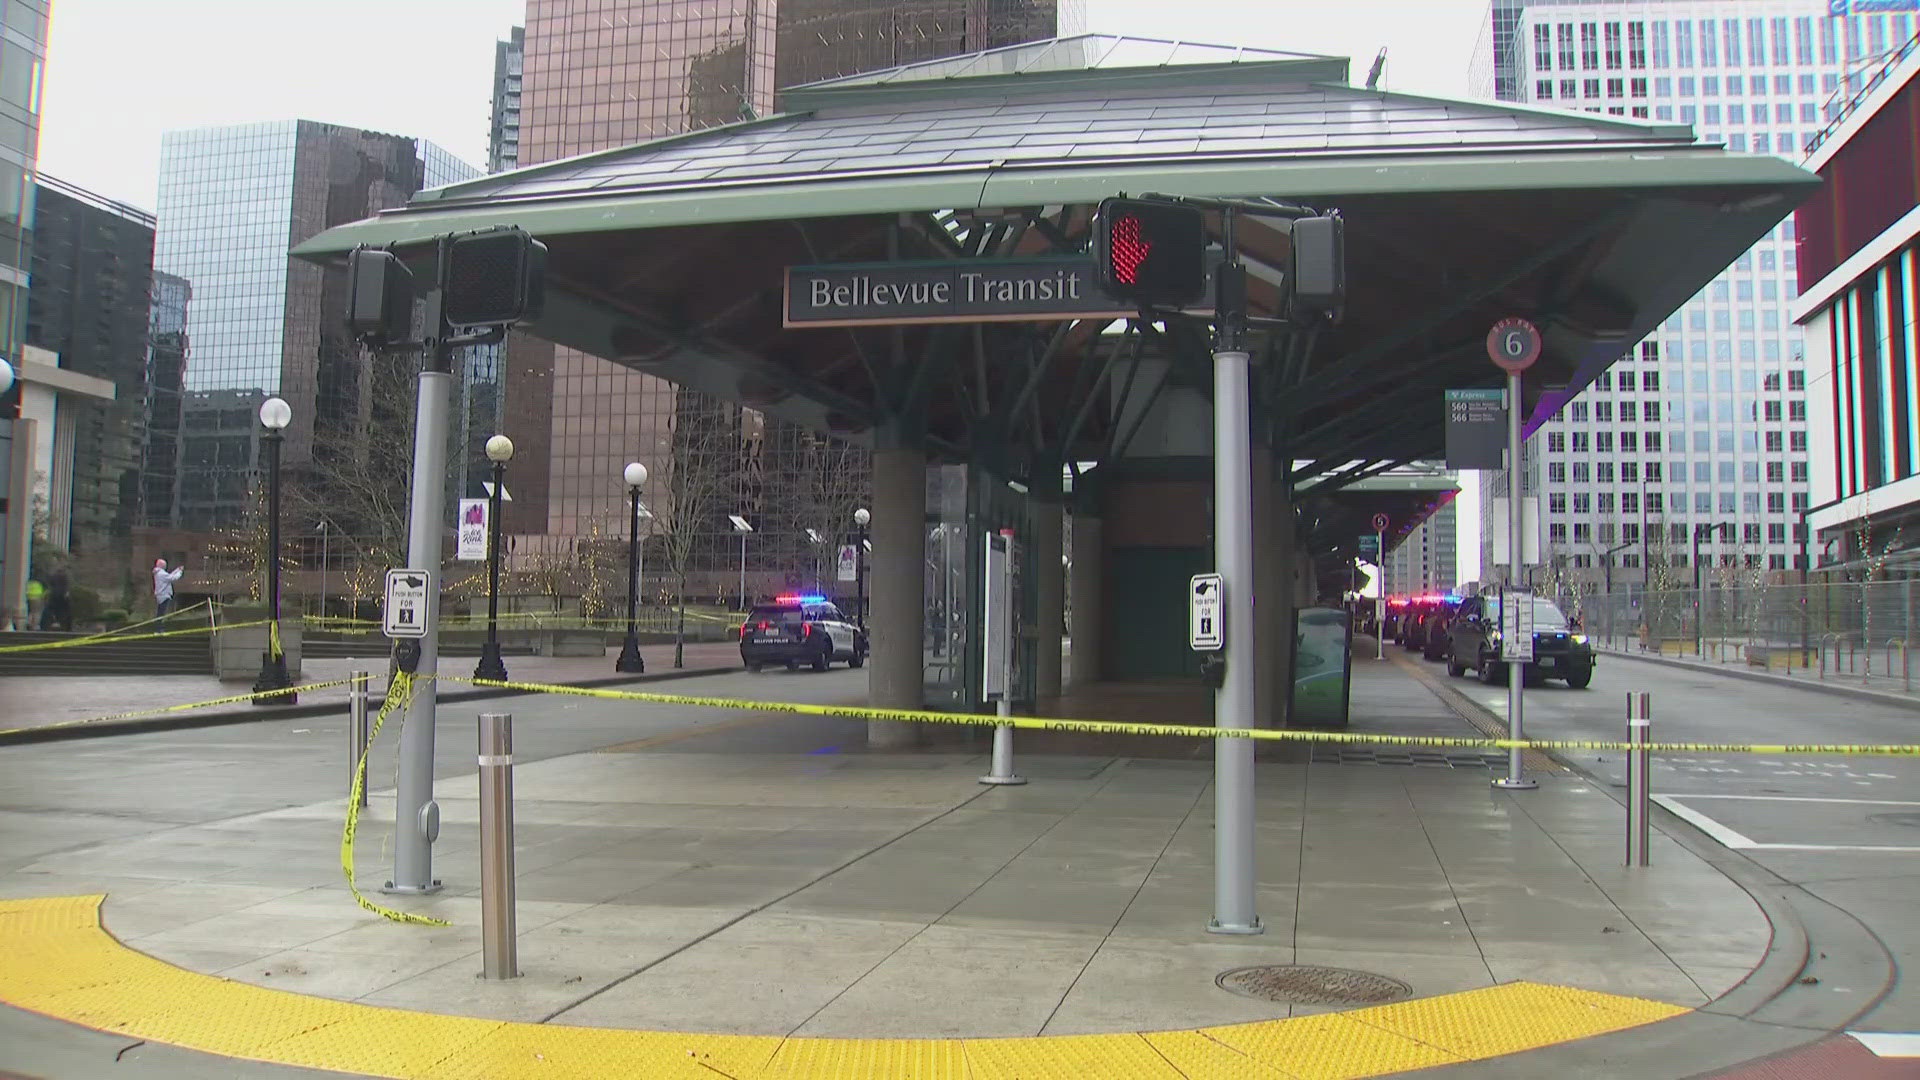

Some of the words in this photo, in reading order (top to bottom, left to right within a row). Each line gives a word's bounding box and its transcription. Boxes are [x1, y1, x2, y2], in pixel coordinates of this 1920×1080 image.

[810, 276, 949, 307] Bellevue
[960, 270, 1080, 302] Transit
[1505, 332, 1522, 355] 6
[1460, 391, 1485, 400] Express
[1452, 402, 1467, 411] 560
[1452, 413, 1467, 422] 566
